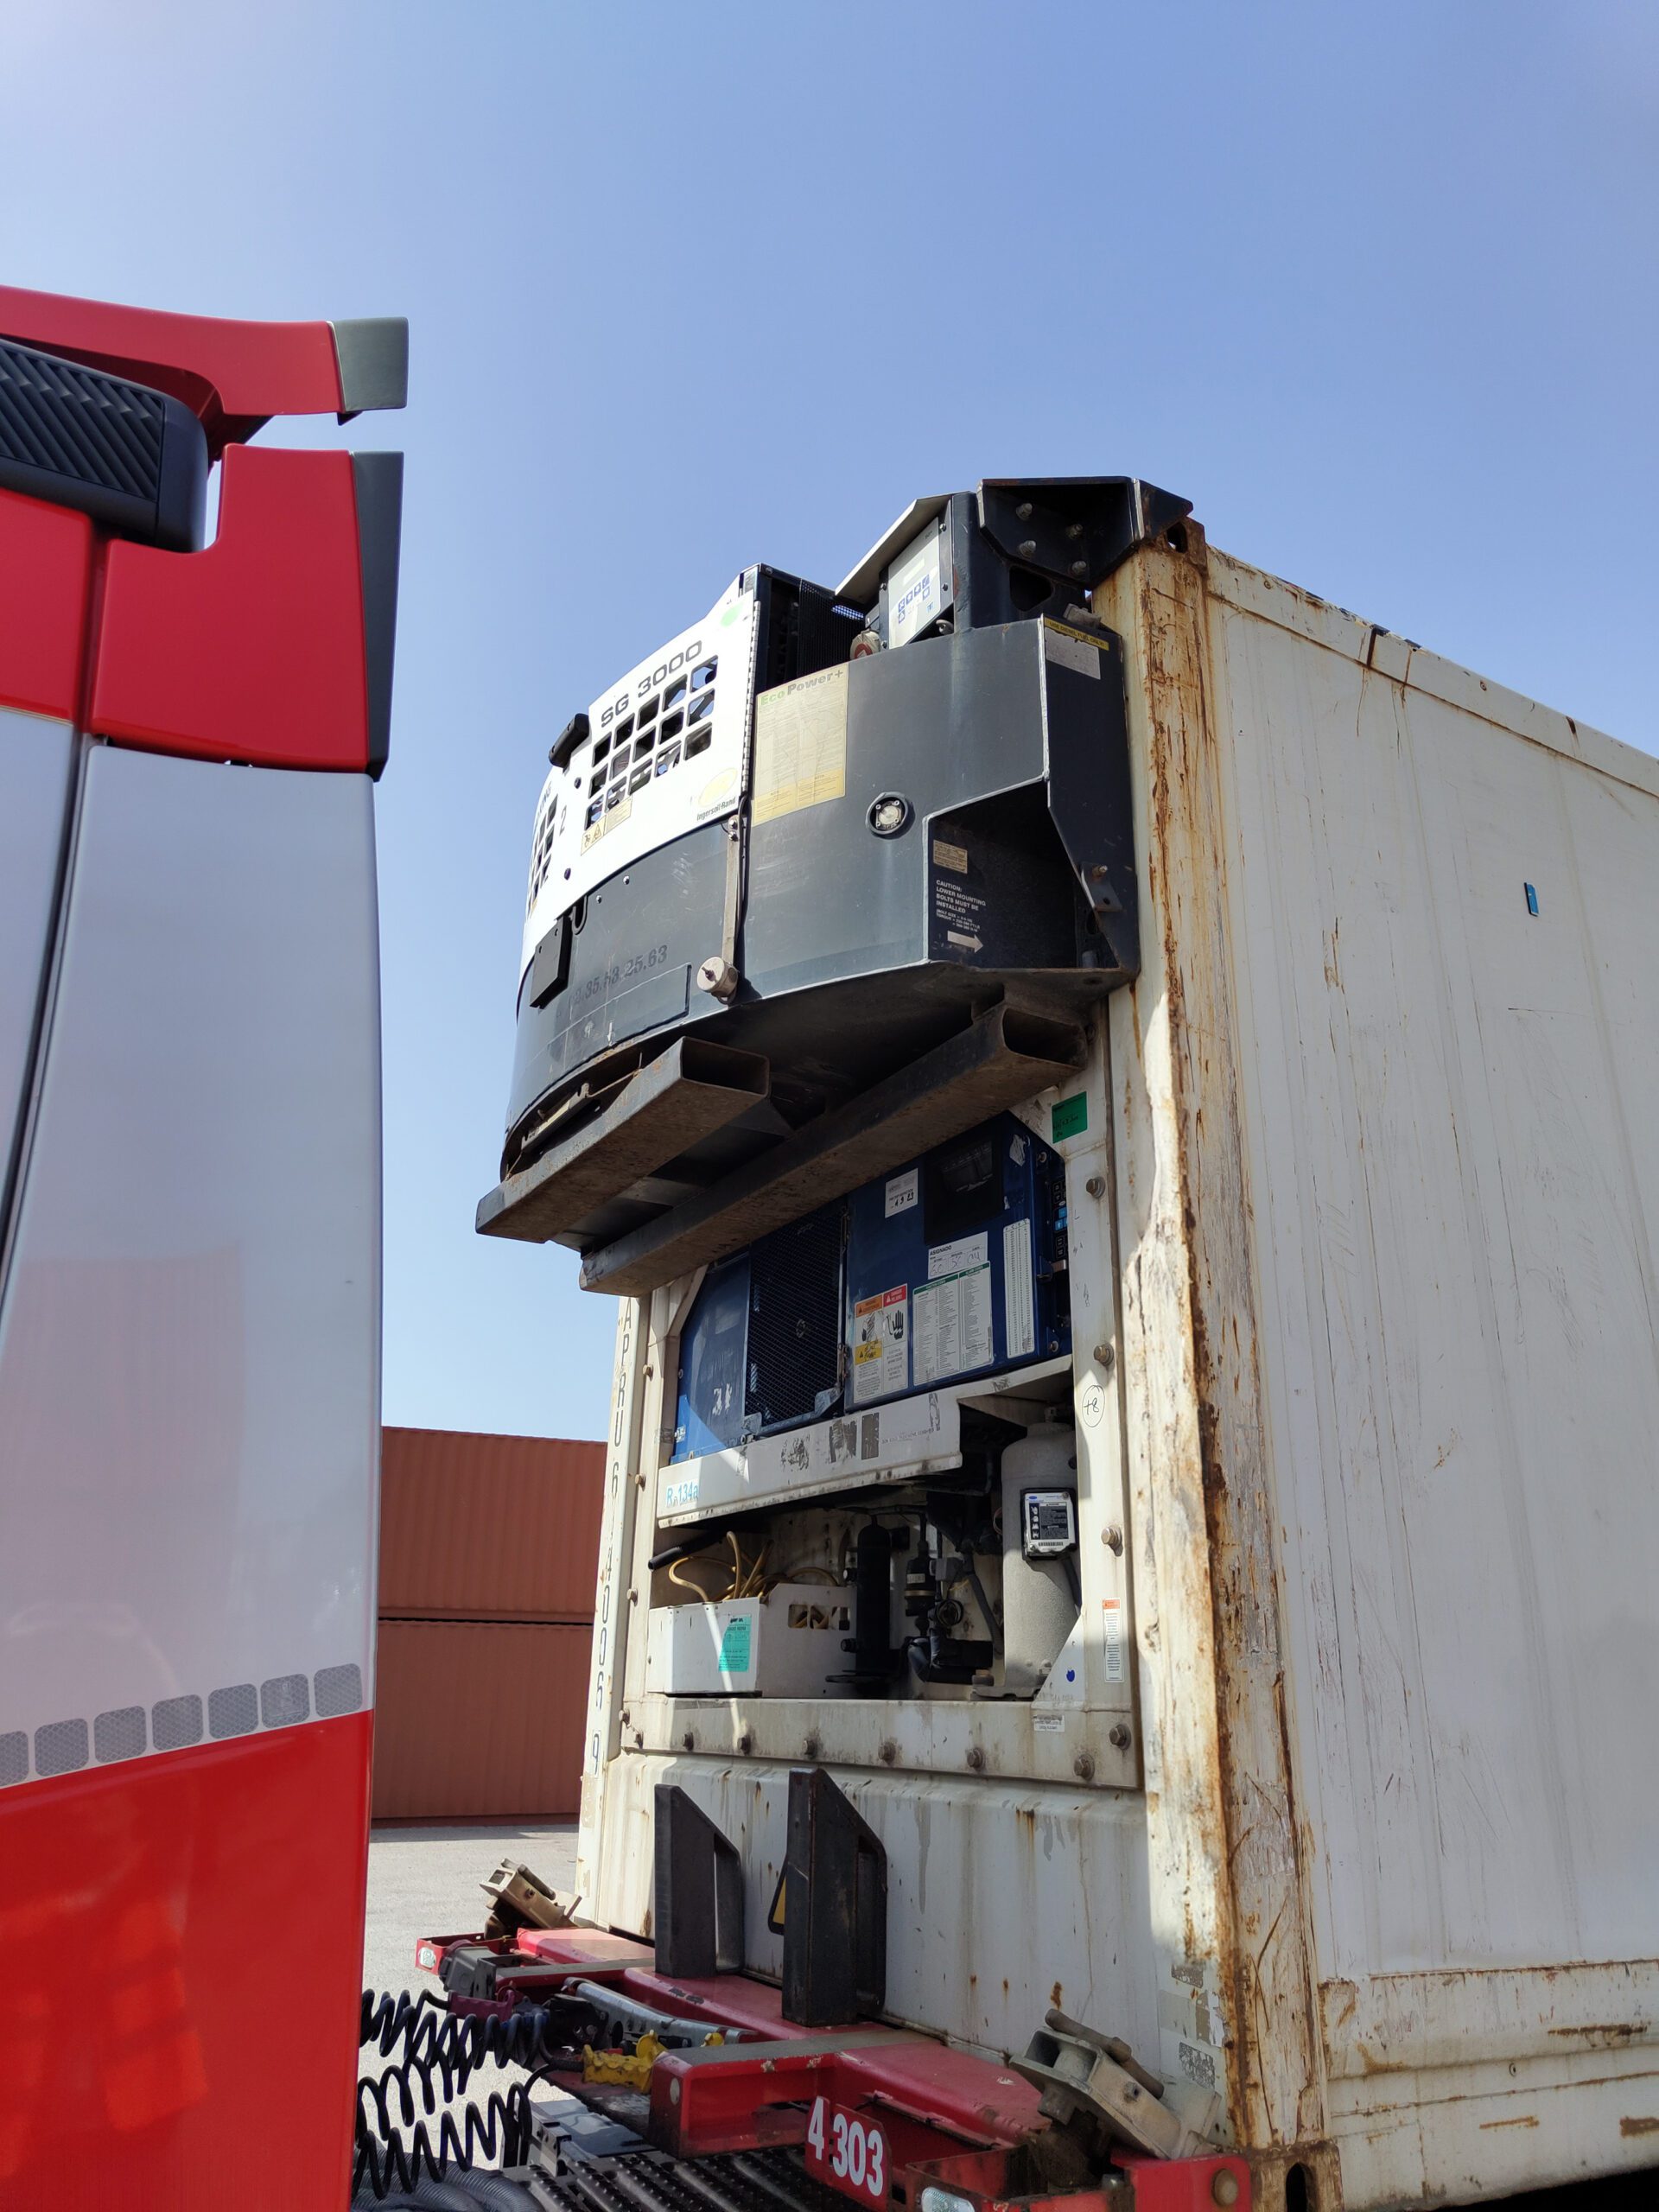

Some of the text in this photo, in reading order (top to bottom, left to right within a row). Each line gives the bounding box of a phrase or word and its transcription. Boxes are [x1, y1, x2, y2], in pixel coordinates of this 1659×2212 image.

[601, 640, 702, 728] SG 3000
[936, 880, 963, 893] CAUTION:
[936, 887, 986, 906] LOWER MOUNTING
[936, 893, 955, 905] BOLTS
[955, 899, 969, 908] MUST
[936, 900, 966, 913] INSTALLED
[930, 1245, 952, 1255] ASIGNADO
[614, 1297, 632, 1448] APRU
[808, 2096, 883, 2196] 4 303
